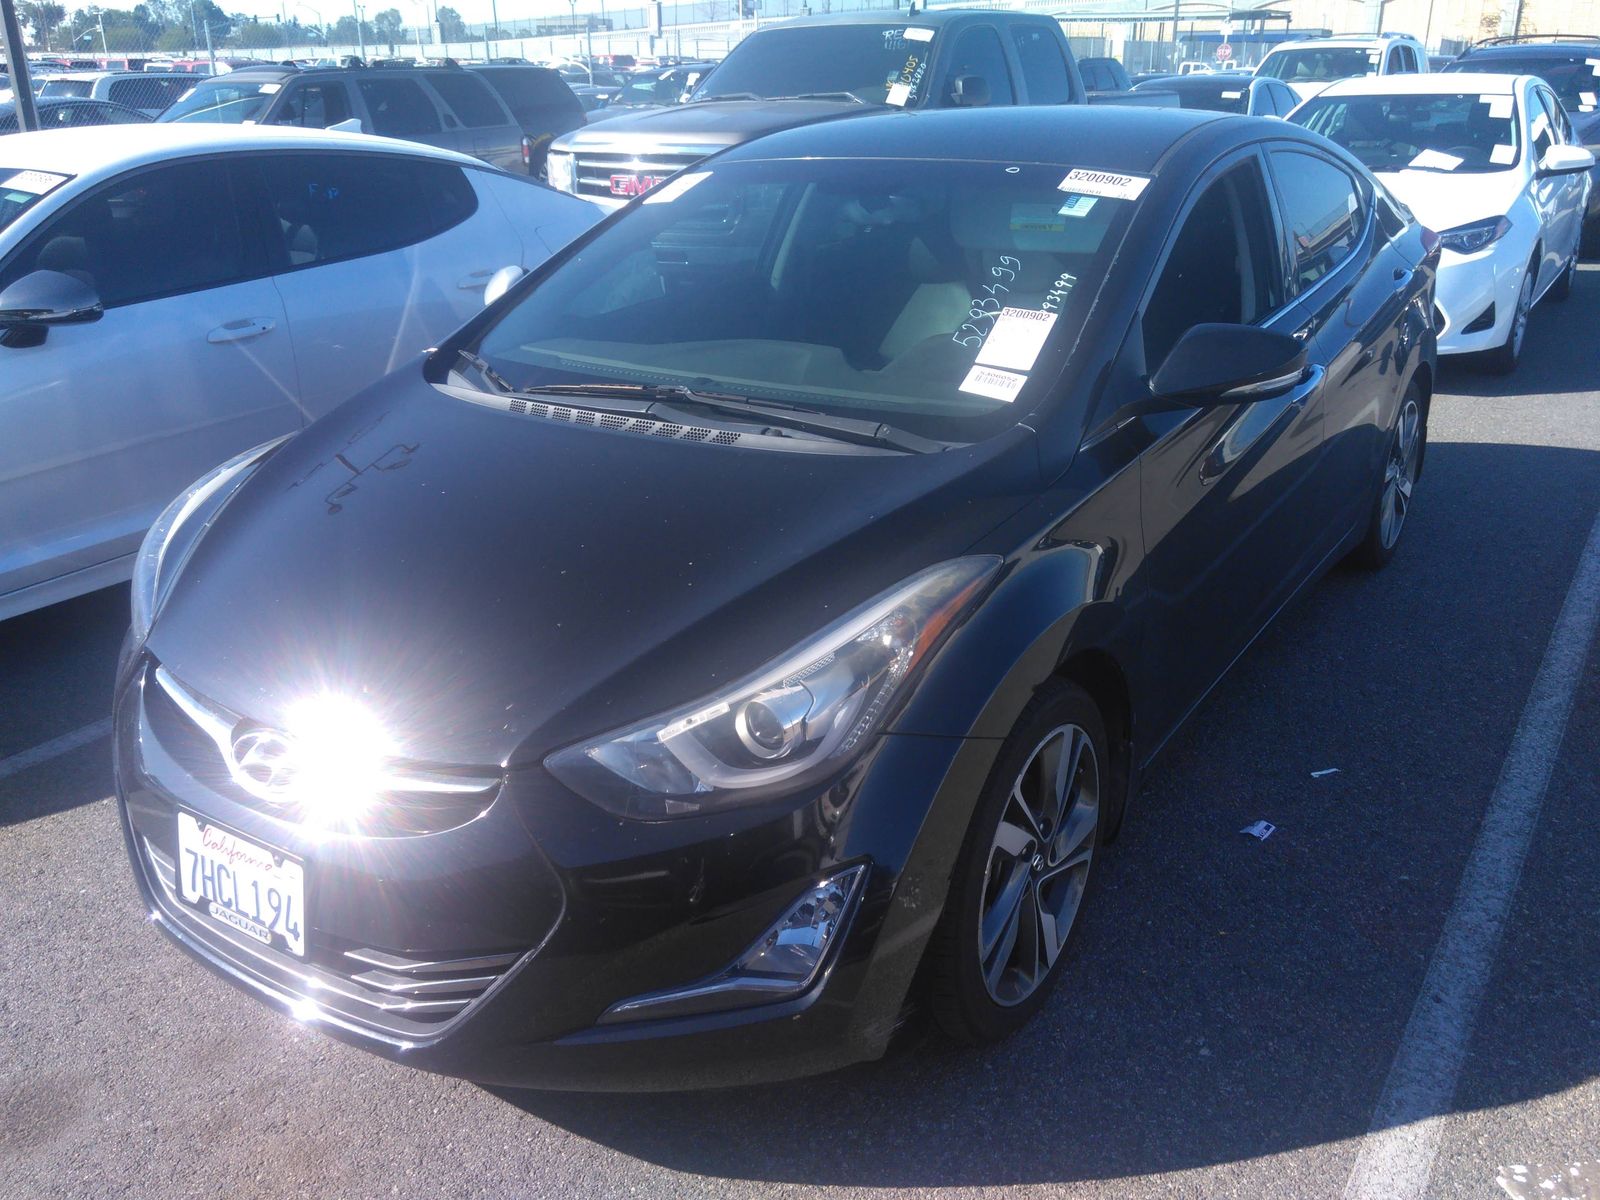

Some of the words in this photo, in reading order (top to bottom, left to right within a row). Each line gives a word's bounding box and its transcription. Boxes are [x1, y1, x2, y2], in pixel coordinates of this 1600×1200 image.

[1069, 171, 1132, 187] 3200902
[952, 255, 1021, 349] 5293499
[1002, 308, 1051, 322] 3200902
[202, 827, 273, 871] California
[185, 847, 300, 942] 7HCL194
[210, 905, 271, 939] JAGUAR
